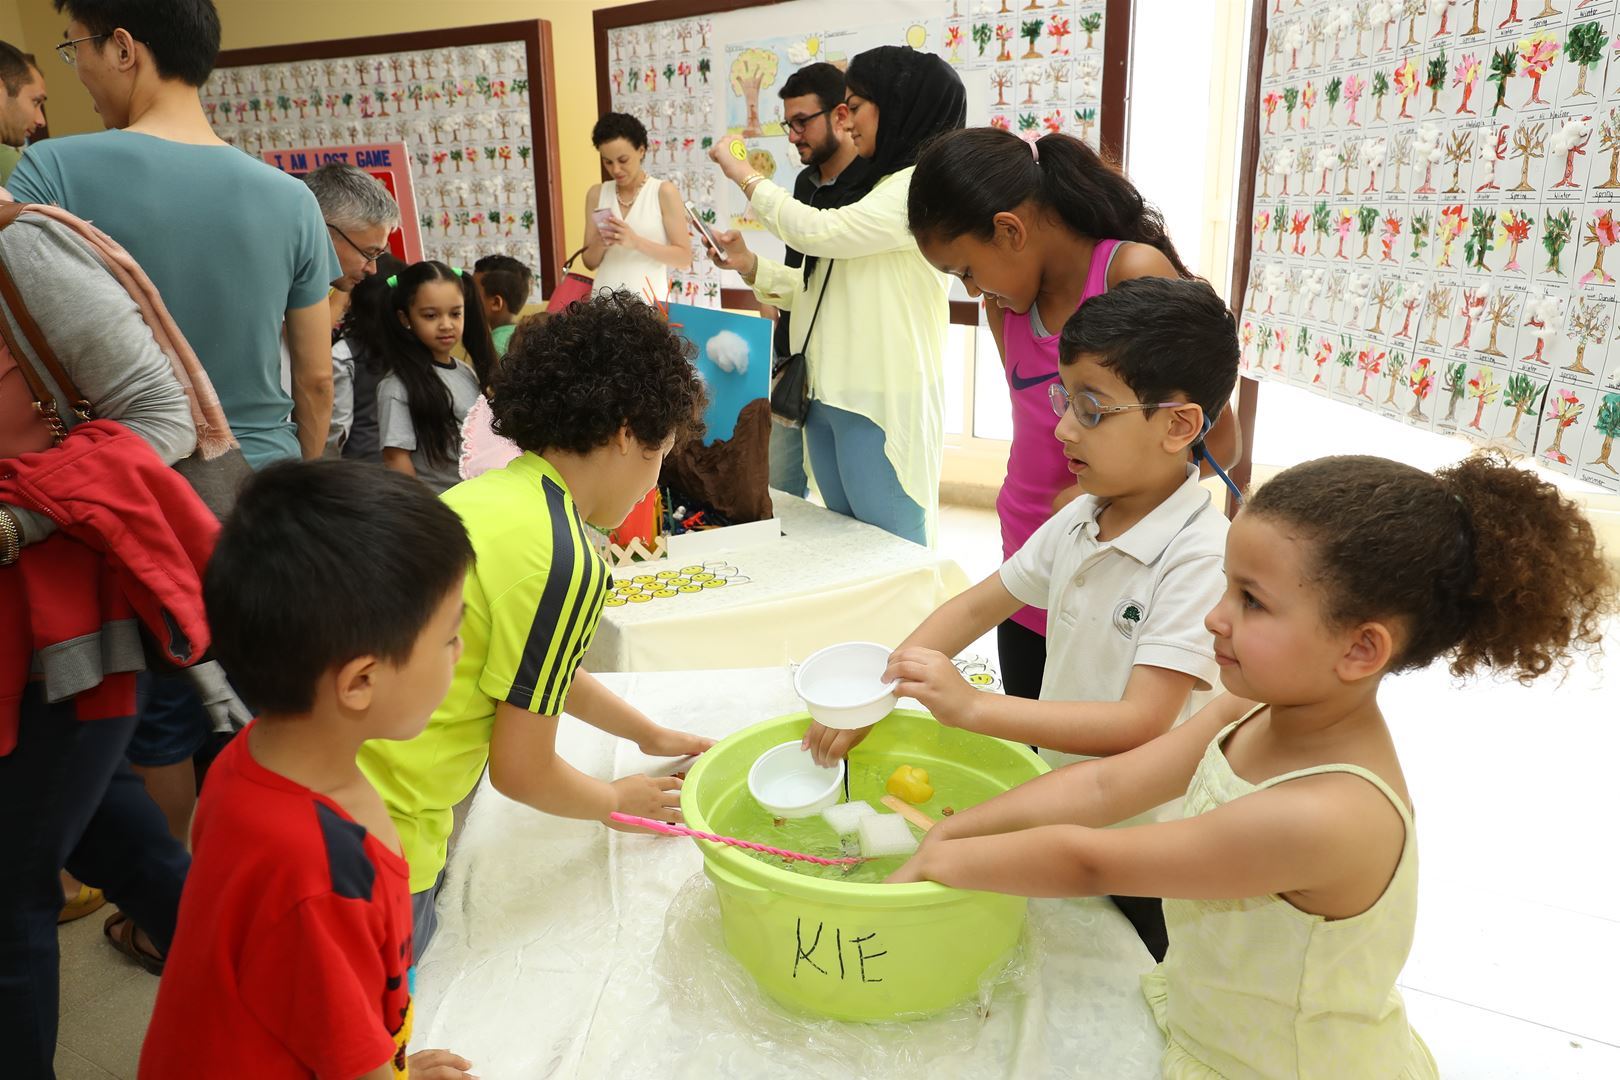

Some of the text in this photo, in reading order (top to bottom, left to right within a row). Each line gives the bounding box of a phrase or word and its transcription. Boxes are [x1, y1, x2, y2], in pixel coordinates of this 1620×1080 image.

[290, 153, 308, 170] AM
[355, 150, 391, 168] GAME
[792, 916, 888, 983] KIE
